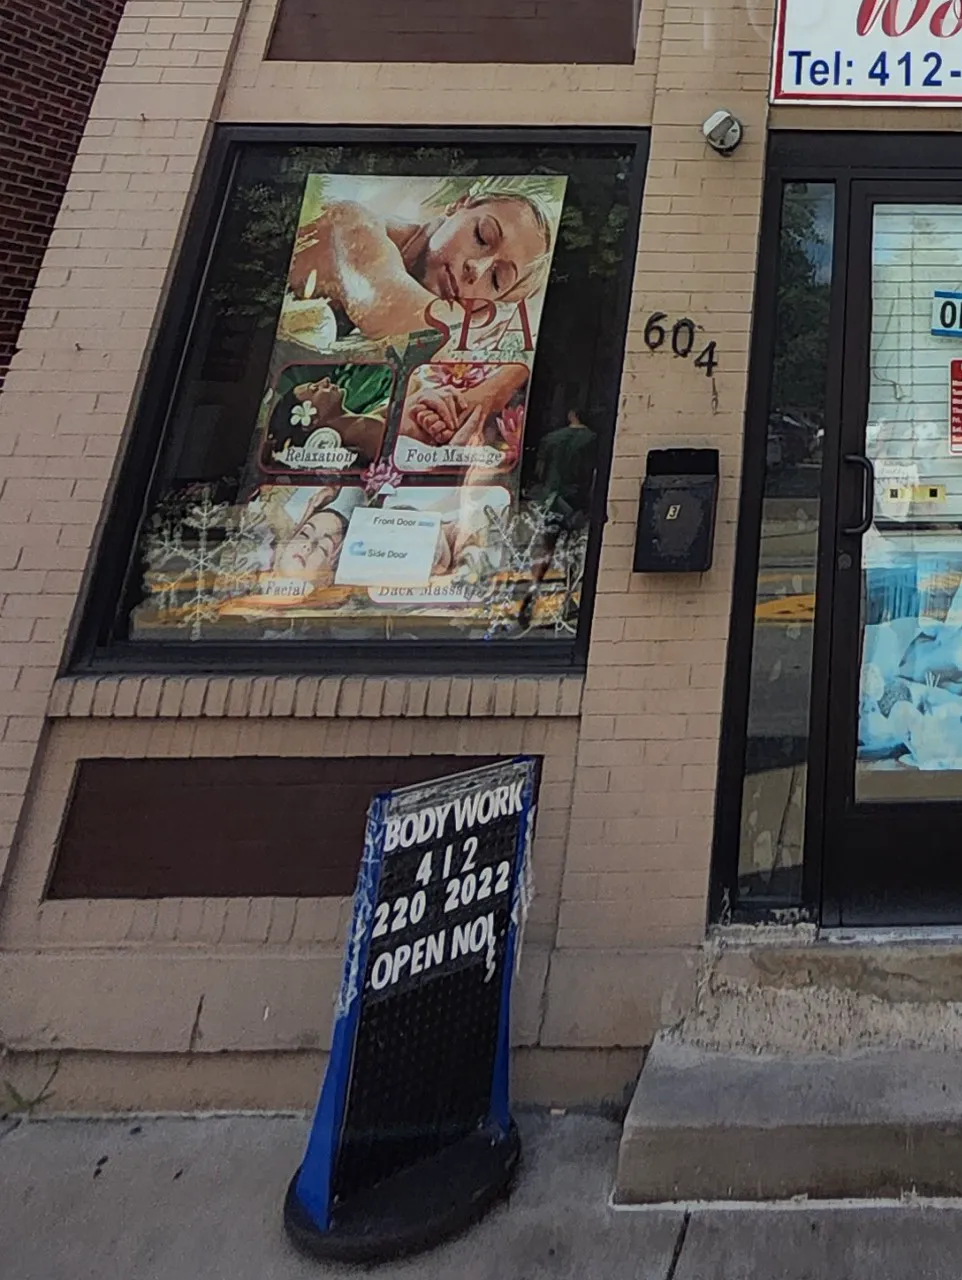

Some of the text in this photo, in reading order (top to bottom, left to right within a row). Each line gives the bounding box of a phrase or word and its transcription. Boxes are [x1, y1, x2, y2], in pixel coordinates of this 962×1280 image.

[788, 50, 853, 87] Tel:
[424, 297, 537, 353] SPA
[643, 311, 718, 377] 604
[284, 447, 352, 463] Relaxation
[405, 448, 502, 465] Foot Masge
[373, 516, 417, 526] Front Door
[367, 549, 408, 559] Side Door
[265, 580, 308, 597] Facial
[371, 860, 511, 939] 220 2022
[371, 929, 446, 990] OPEN
